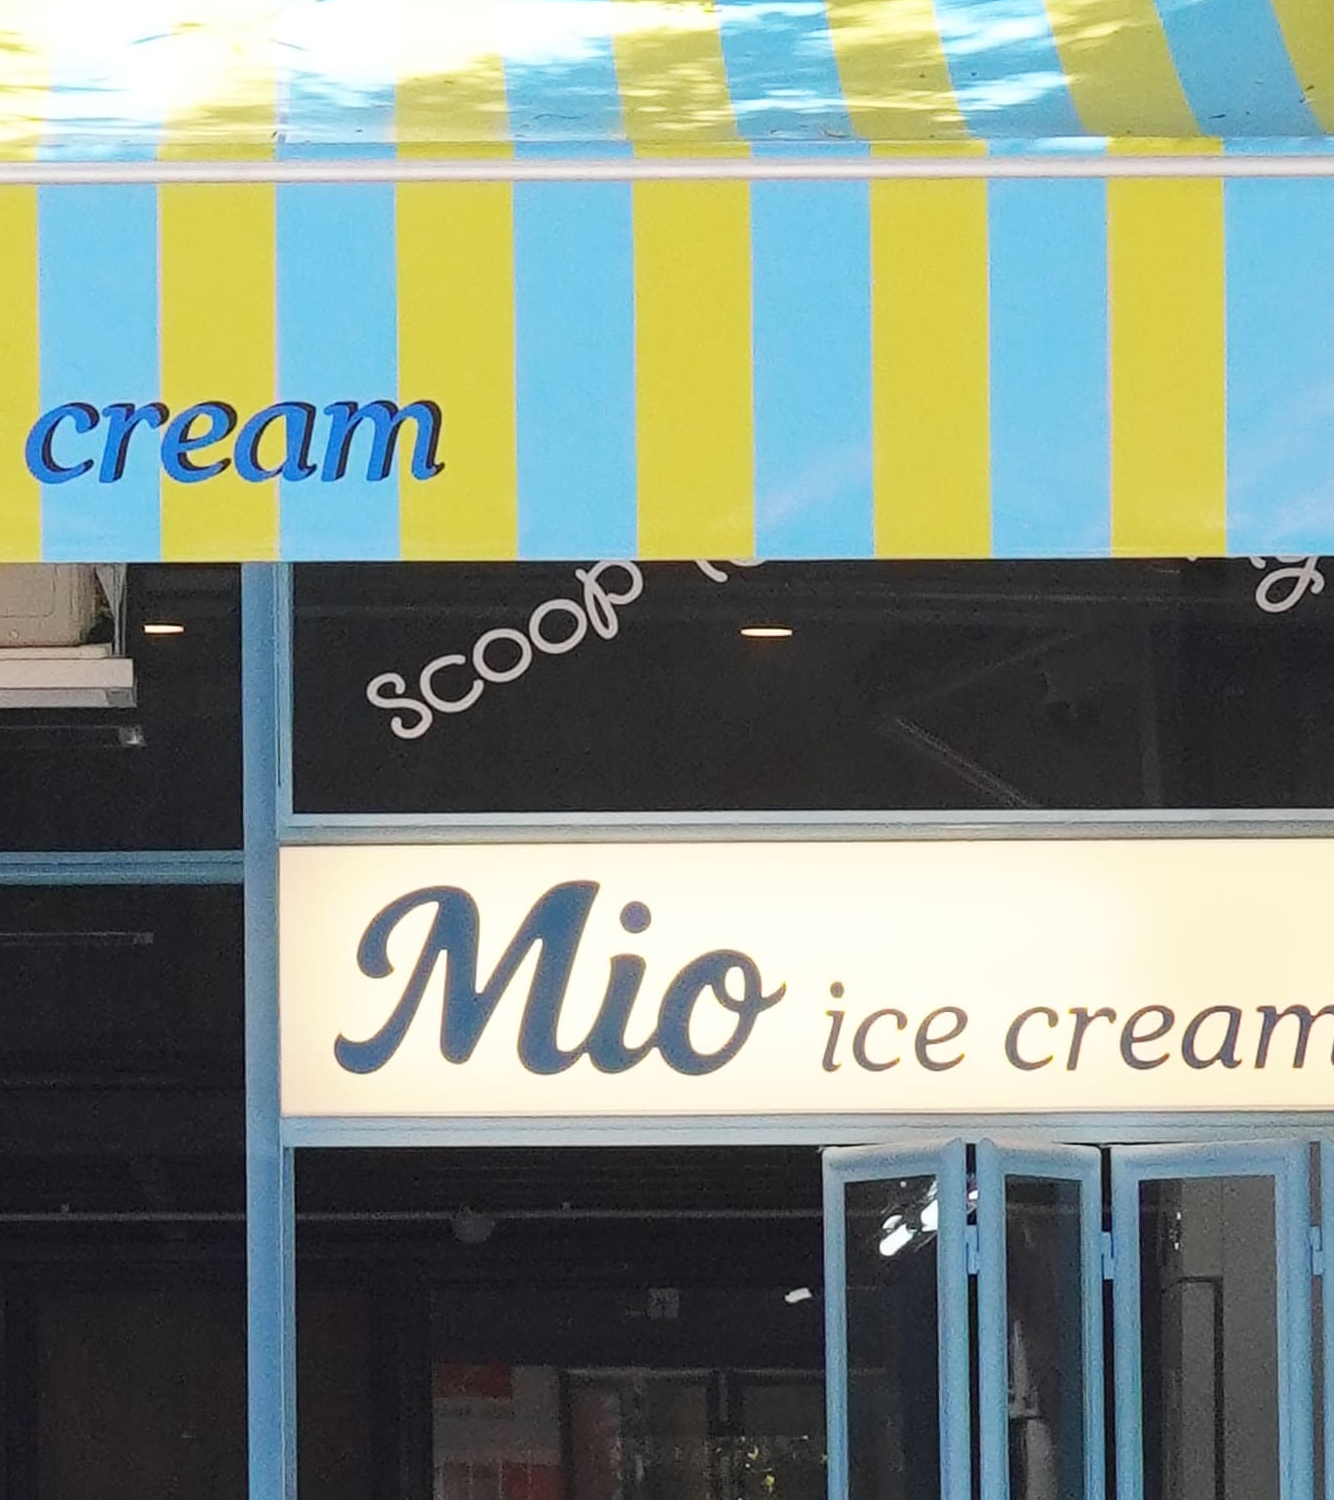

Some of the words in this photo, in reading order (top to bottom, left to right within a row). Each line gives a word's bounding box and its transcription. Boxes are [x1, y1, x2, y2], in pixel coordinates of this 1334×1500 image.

[25, 400, 445, 484] cream
[334, 879, 787, 1077] Mio
[820, 981, 968, 1073] ice
